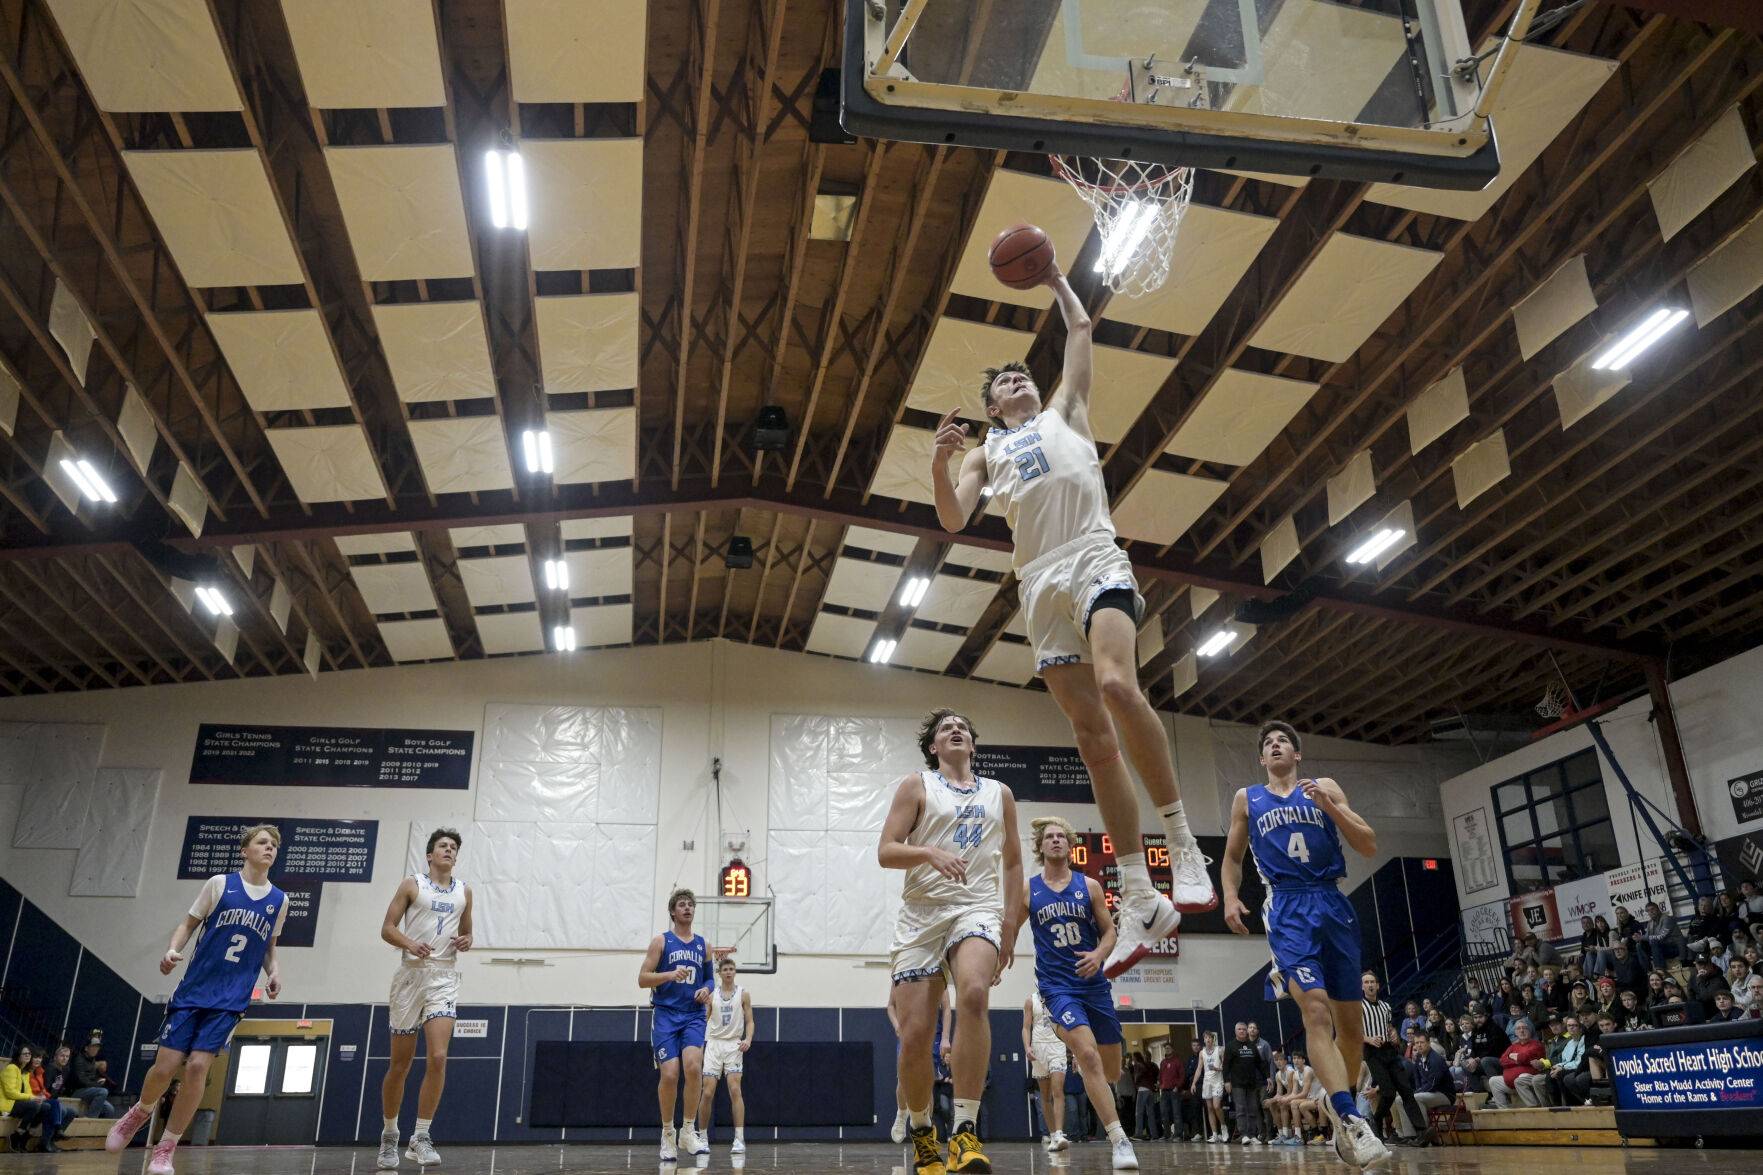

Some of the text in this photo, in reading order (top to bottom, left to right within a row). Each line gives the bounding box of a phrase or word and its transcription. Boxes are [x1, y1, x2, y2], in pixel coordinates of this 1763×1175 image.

[1004, 432, 1042, 456] LSH
[1014, 446, 1050, 481] 21
[955, 804, 986, 818] LSH
[1257, 805, 1324, 838] CORVALLIS
[953, 824, 983, 849] 44
[1148, 848, 1169, 866] 05
[1288, 832, 1310, 863] 4
[725, 876, 748, 896] 33
[1622, 890, 1643, 903] KNIFE
[1037, 902, 1086, 925] CORVALLIS
[1529, 908, 1542, 923] JE
[1568, 902, 1596, 917] WMOP
[216, 908, 270, 941] CORVALLIS
[437, 916, 444, 935] 1
[1051, 922, 1082, 948] 30
[224, 934, 247, 963] 2
[1151, 938, 1177, 954] ERS
[668, 950, 703, 968] CORVALLIS
[1613, 1055, 1643, 1078] Loyola
[1644, 1052, 1676, 1073] Sacred
[1677, 1050, 1707, 1072] Heart
[1707, 1048, 1733, 1073] High
[1634, 1077, 1754, 1092] Sister Rita Mudd Activity Center
[1637, 1093, 1663, 1103] "Home
[1664, 1092, 1672, 1103] of
[1673, 1092, 1685, 1102] the
[1687, 1092, 1708, 1102] Rams
[1710, 1092, 1717, 1101] &
